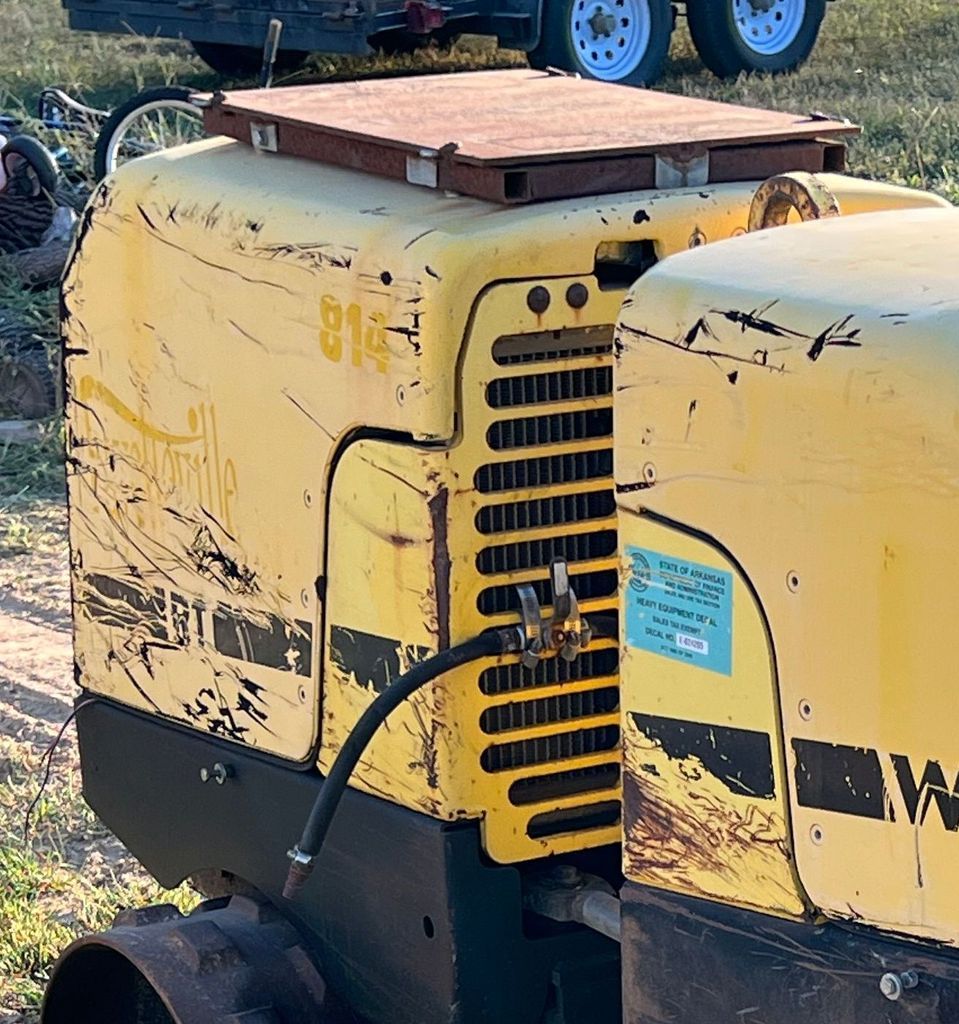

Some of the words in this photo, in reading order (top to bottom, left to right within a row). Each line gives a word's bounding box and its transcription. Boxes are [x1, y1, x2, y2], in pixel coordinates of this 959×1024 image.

[319, 294, 390, 375] 814
[659, 560, 678, 573] STATE
[679, 566, 689, 575] OF
[690, 569, 725, 587] ARKANSAS
[636, 597, 657, 609] HEAVY
[658, 602, 694, 620] EQUIPMENT
[695, 613, 718, 628] DECAL
[652, 615, 669, 626] SALES
[680, 624, 702, 635] EXEMPT
[645, 627, 664, 640] DECAL
